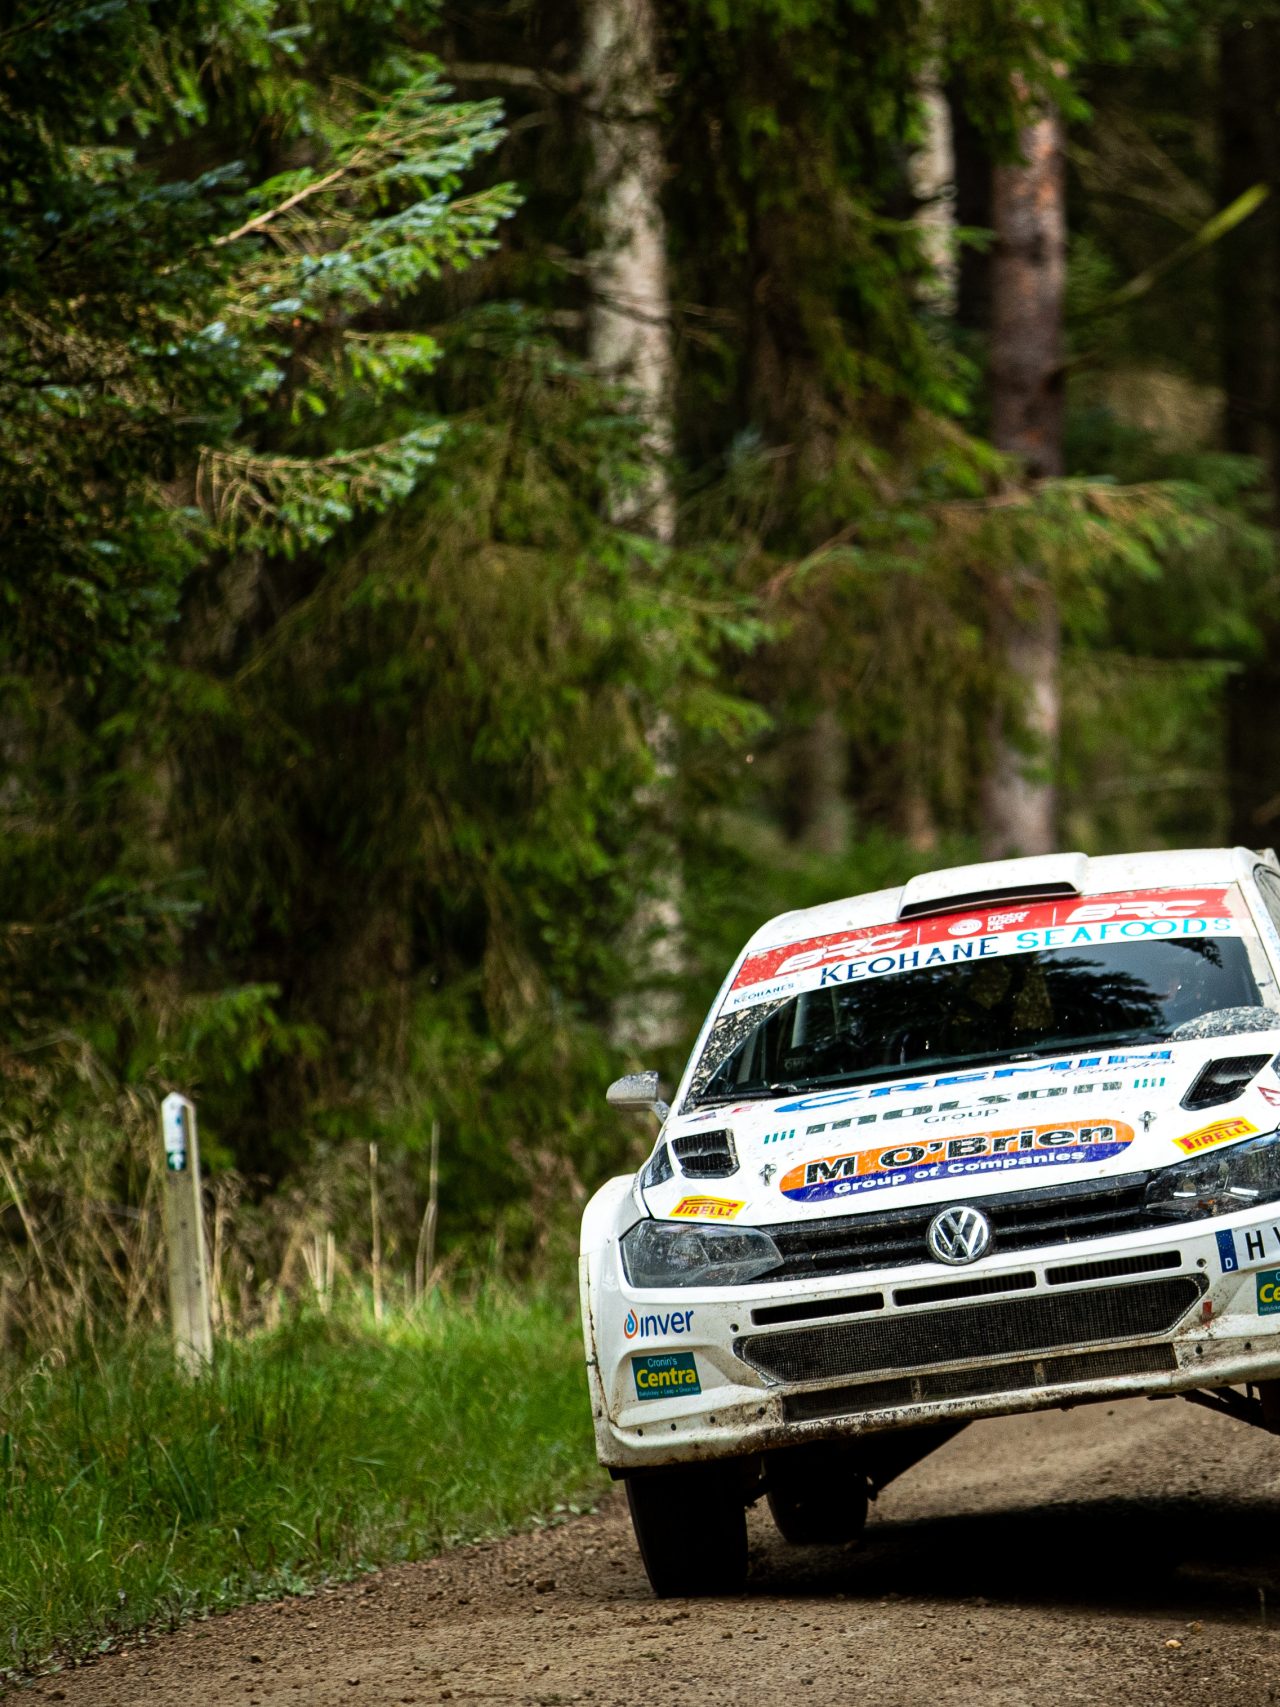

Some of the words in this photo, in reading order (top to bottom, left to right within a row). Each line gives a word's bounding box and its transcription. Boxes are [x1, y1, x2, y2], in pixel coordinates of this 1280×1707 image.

[987, 911, 1031, 922] motor
[1065, 900, 1207, 924] BRC
[774, 928, 912, 976] BRC
[819, 936, 999, 987] KEOHANE
[1015, 917, 1232, 950] SEAFOODS
[773, 1050, 1172, 1113] CREMIN
[923, 1107, 999, 1124] Group
[1179, 1120, 1250, 1150] PIRELLI
[805, 1156, 856, 1186] M
[879, 1124, 1116, 1168] O'Brien
[833, 1172, 907, 1194] Group
[914, 1165, 940, 1180] of
[947, 1150, 1086, 1174] Companies
[675, 1199, 738, 1217] PIRELLI
[1245, 1230, 1266, 1261] H
[1224, 1257, 1234, 1270] D
[640, 1310, 694, 1338] inver
[647, 1356, 678, 1368] Cronin's
[636, 1367, 697, 1389] Centra
